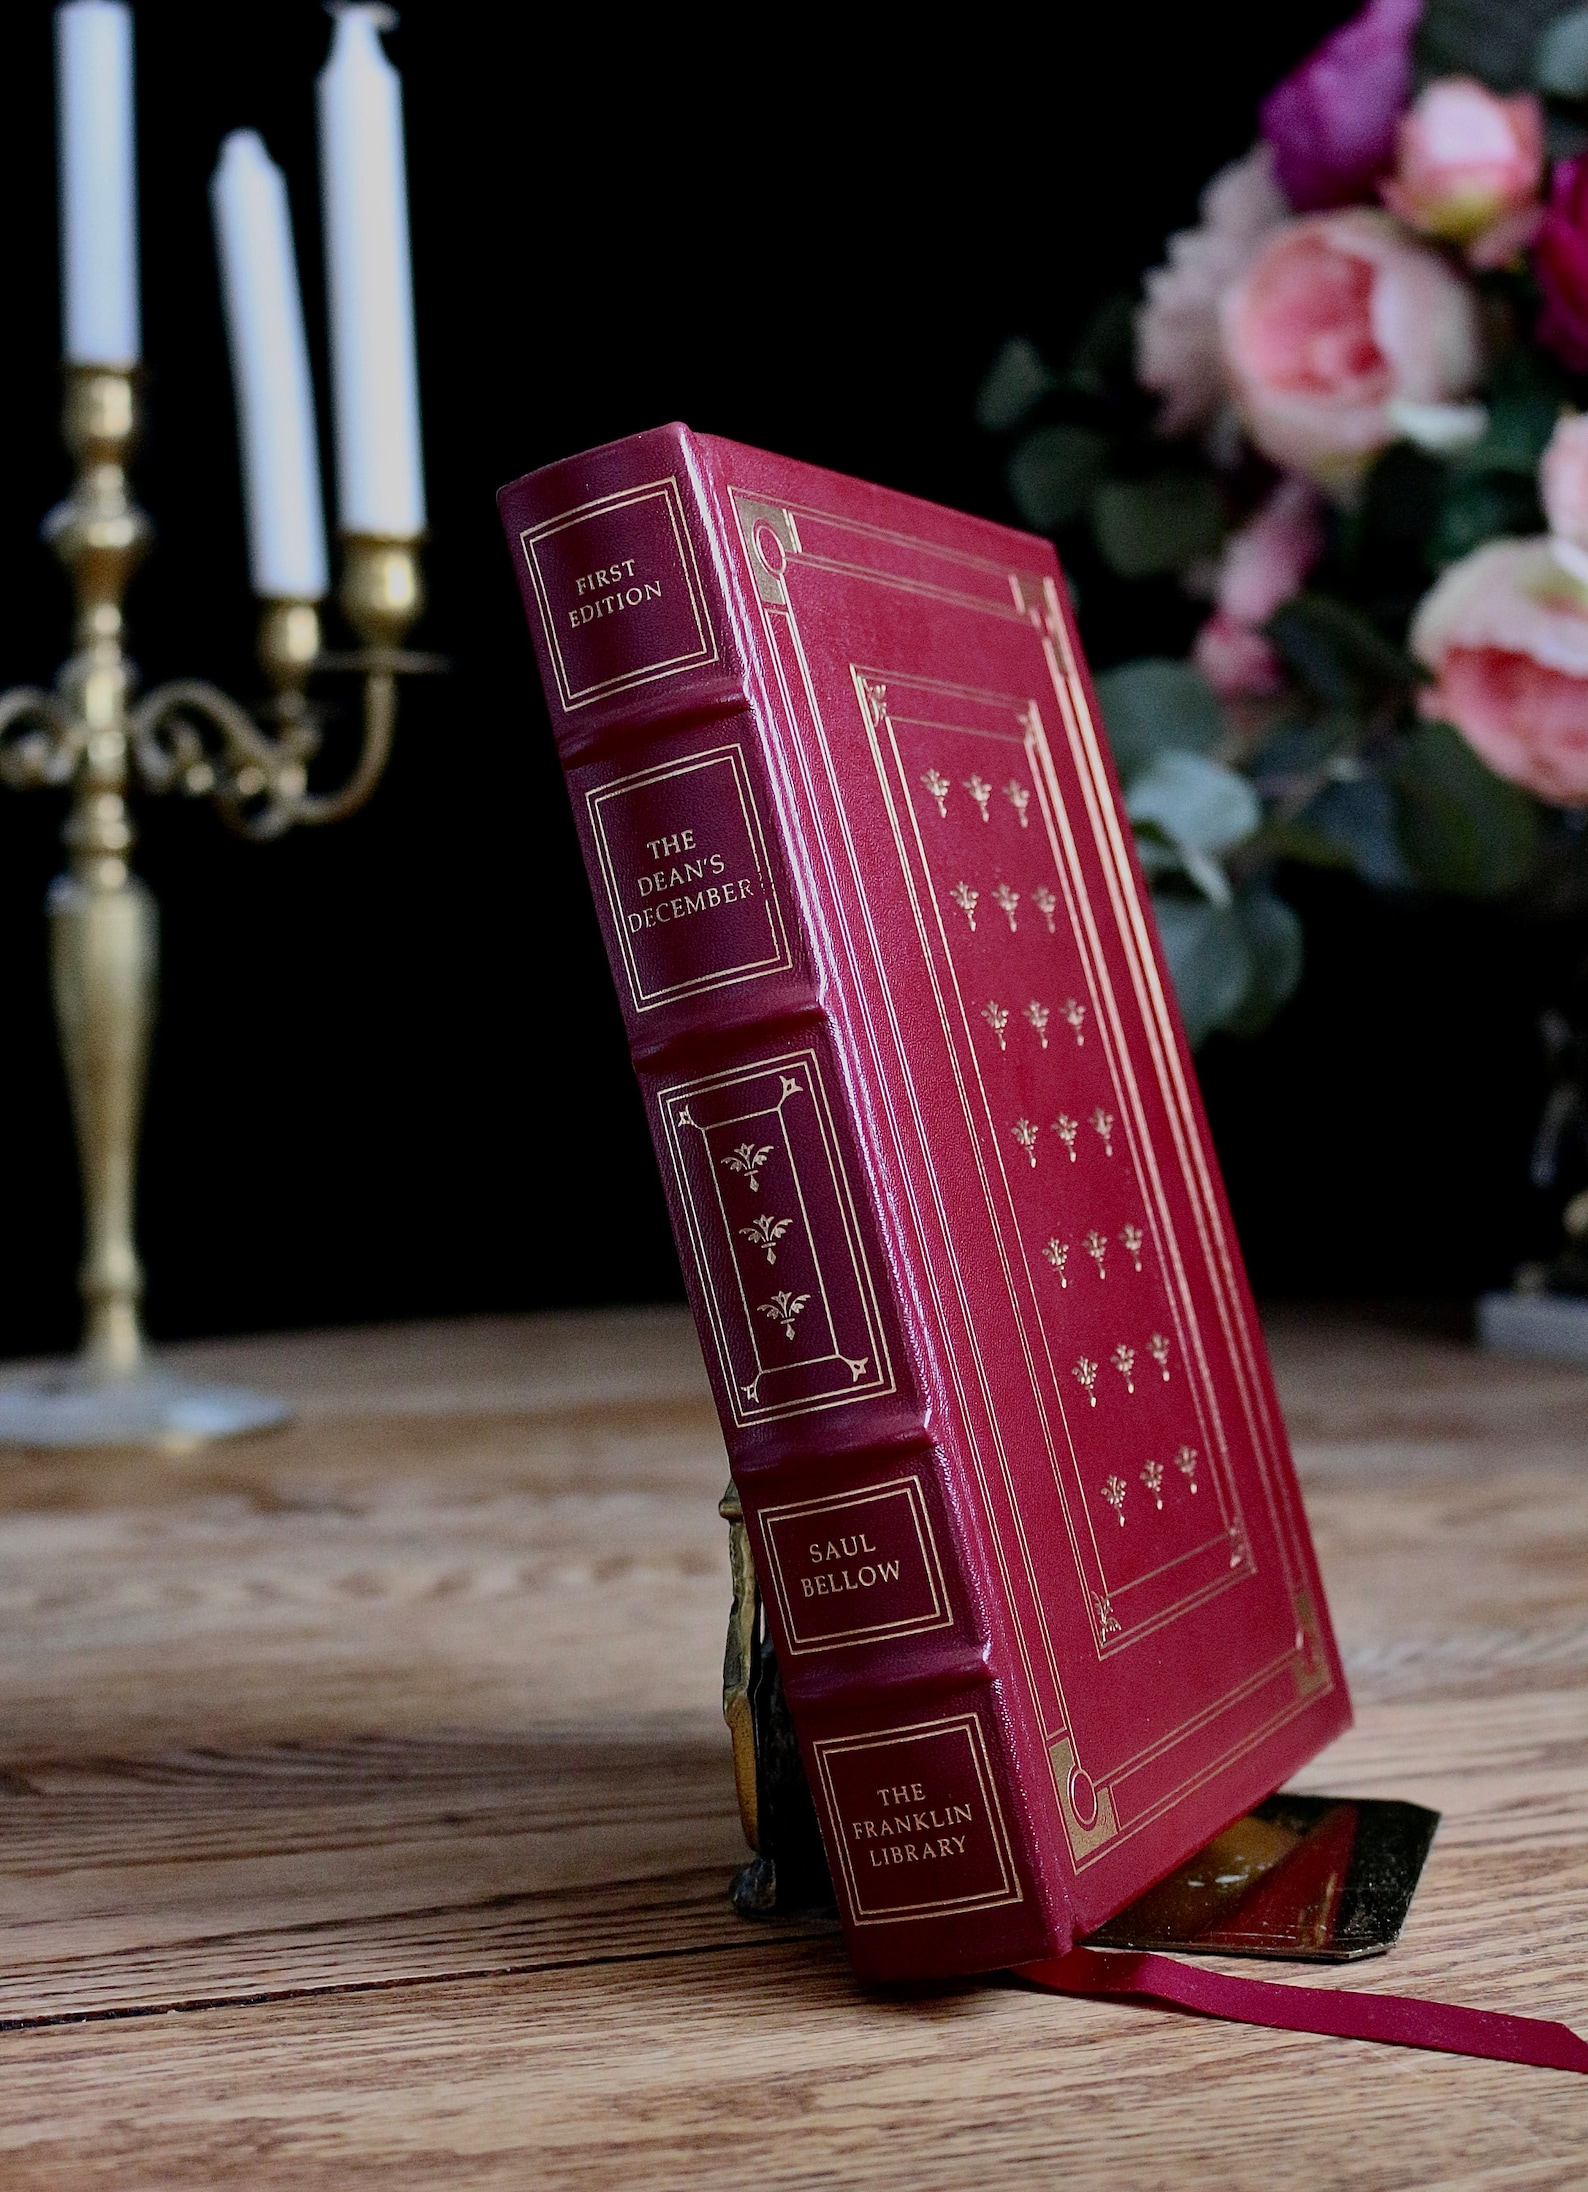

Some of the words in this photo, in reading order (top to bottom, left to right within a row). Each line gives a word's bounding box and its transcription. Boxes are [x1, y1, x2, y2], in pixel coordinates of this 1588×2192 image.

[576, 559, 635, 596] FIRST
[568, 580, 661, 628] EDITION
[646, 829, 696, 860] THE
[637, 854, 725, 897] DEAN'S
[627, 878, 754, 933] DECEMBER
[809, 1534, 876, 1563] SAUL
[801, 1560, 899, 1598] BELLOW
[877, 1783, 926, 1807] THE
[852, 1803, 973, 1840] FRANKLIN
[870, 1835, 966, 1867] LIBRARY
